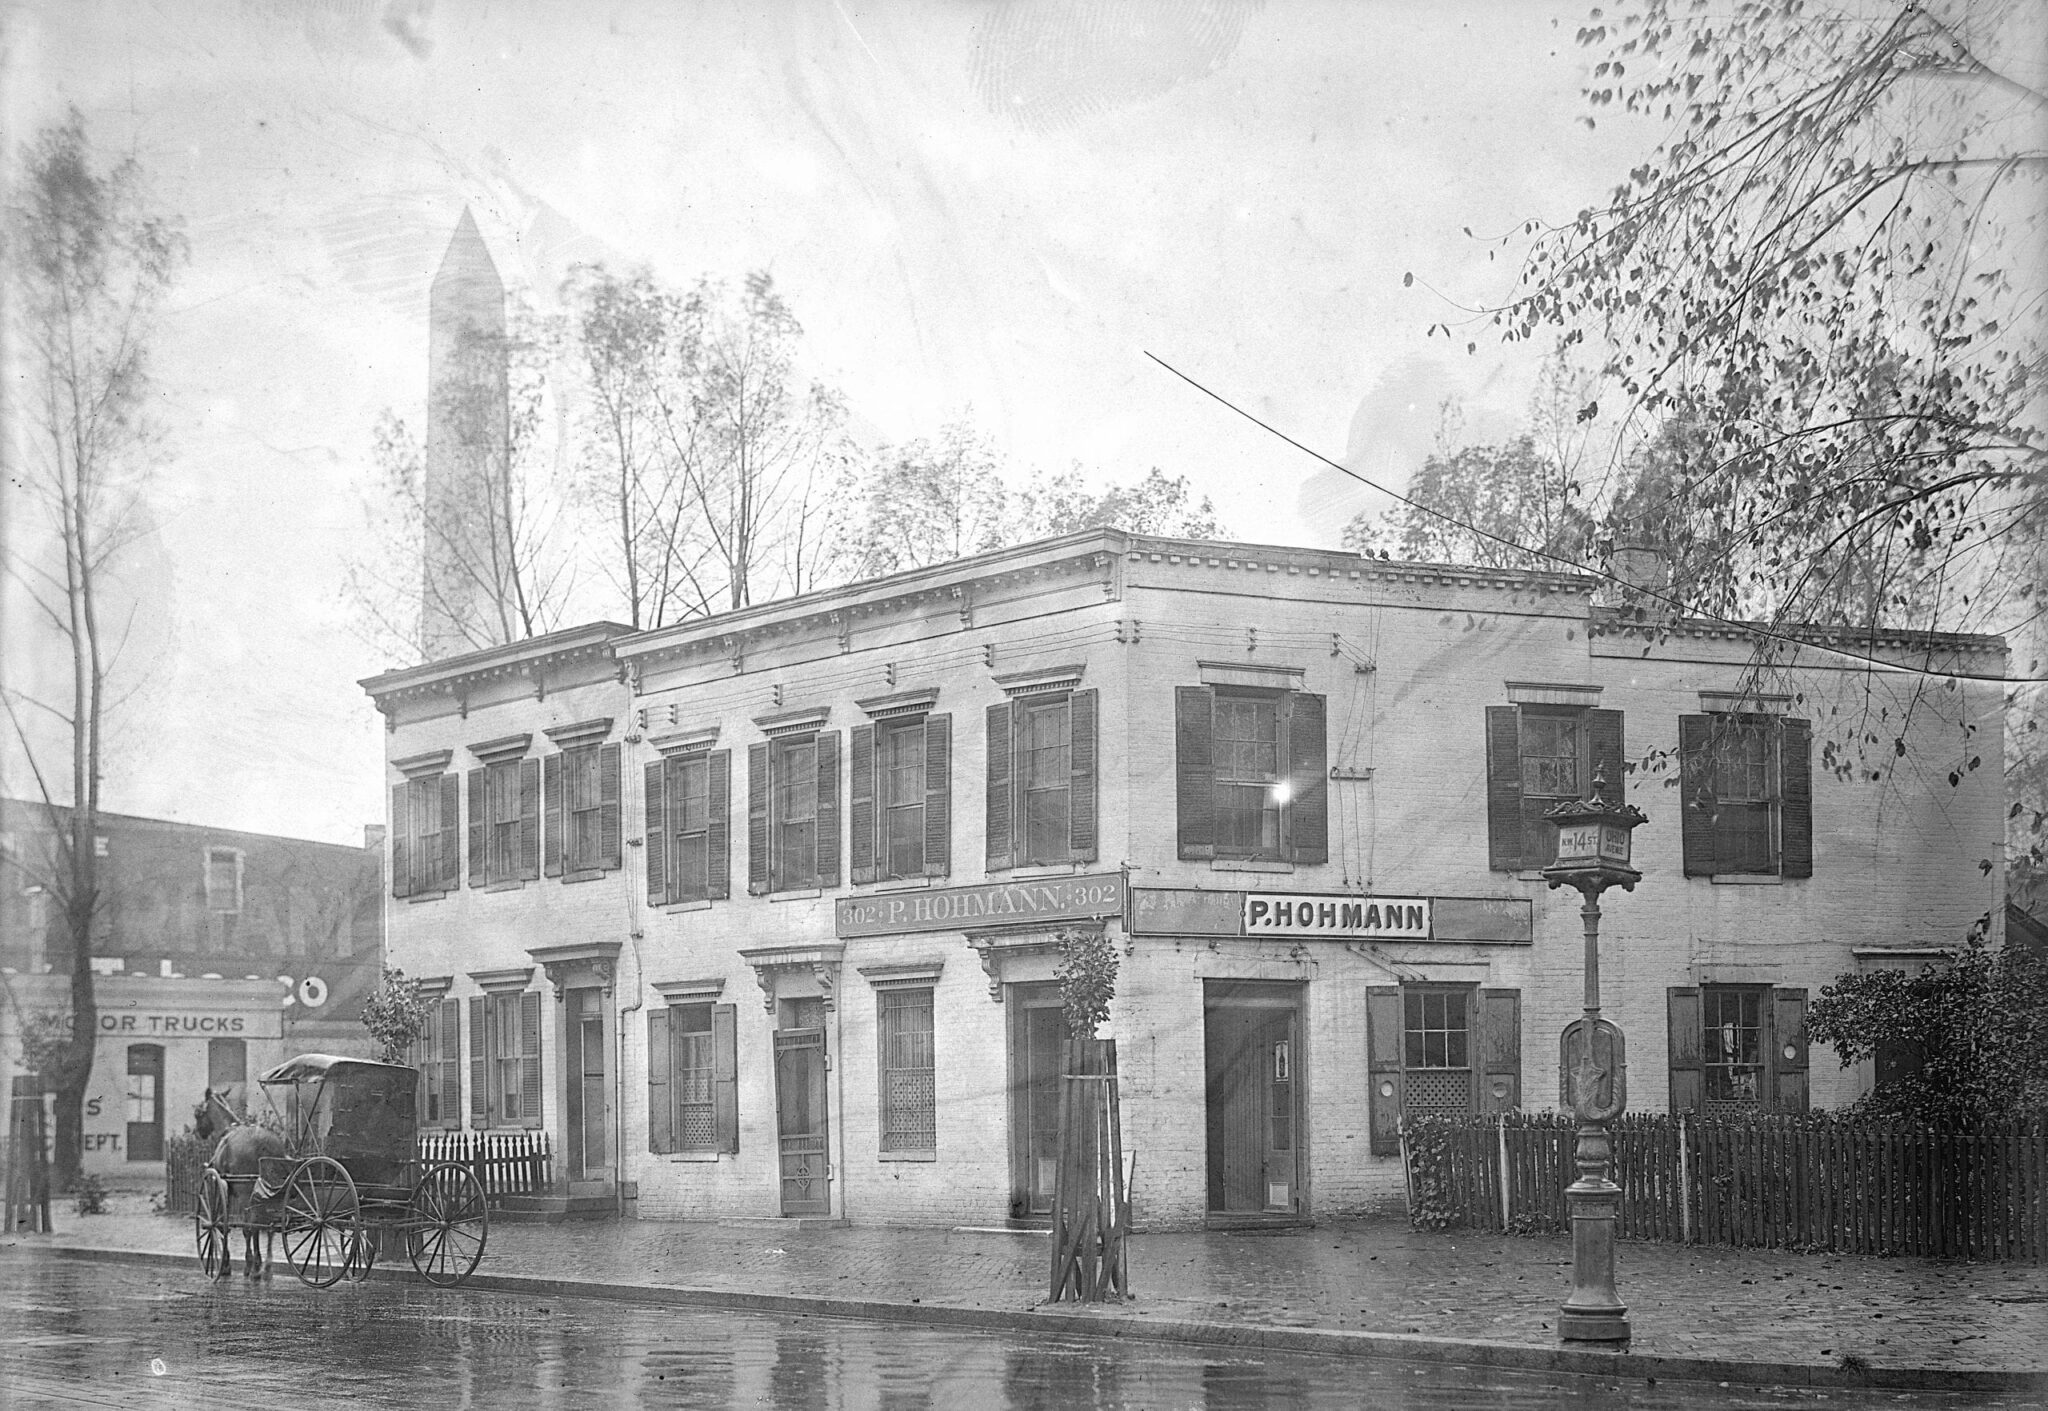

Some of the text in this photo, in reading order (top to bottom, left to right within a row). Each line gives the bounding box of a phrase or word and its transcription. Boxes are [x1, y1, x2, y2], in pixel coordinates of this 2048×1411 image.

[1573, 832, 1586, 851] 14
[842, 906, 876, 925] 302
[1075, 885, 1116, 906] 302
[149, 1015, 245, 1032] TRUCKS
